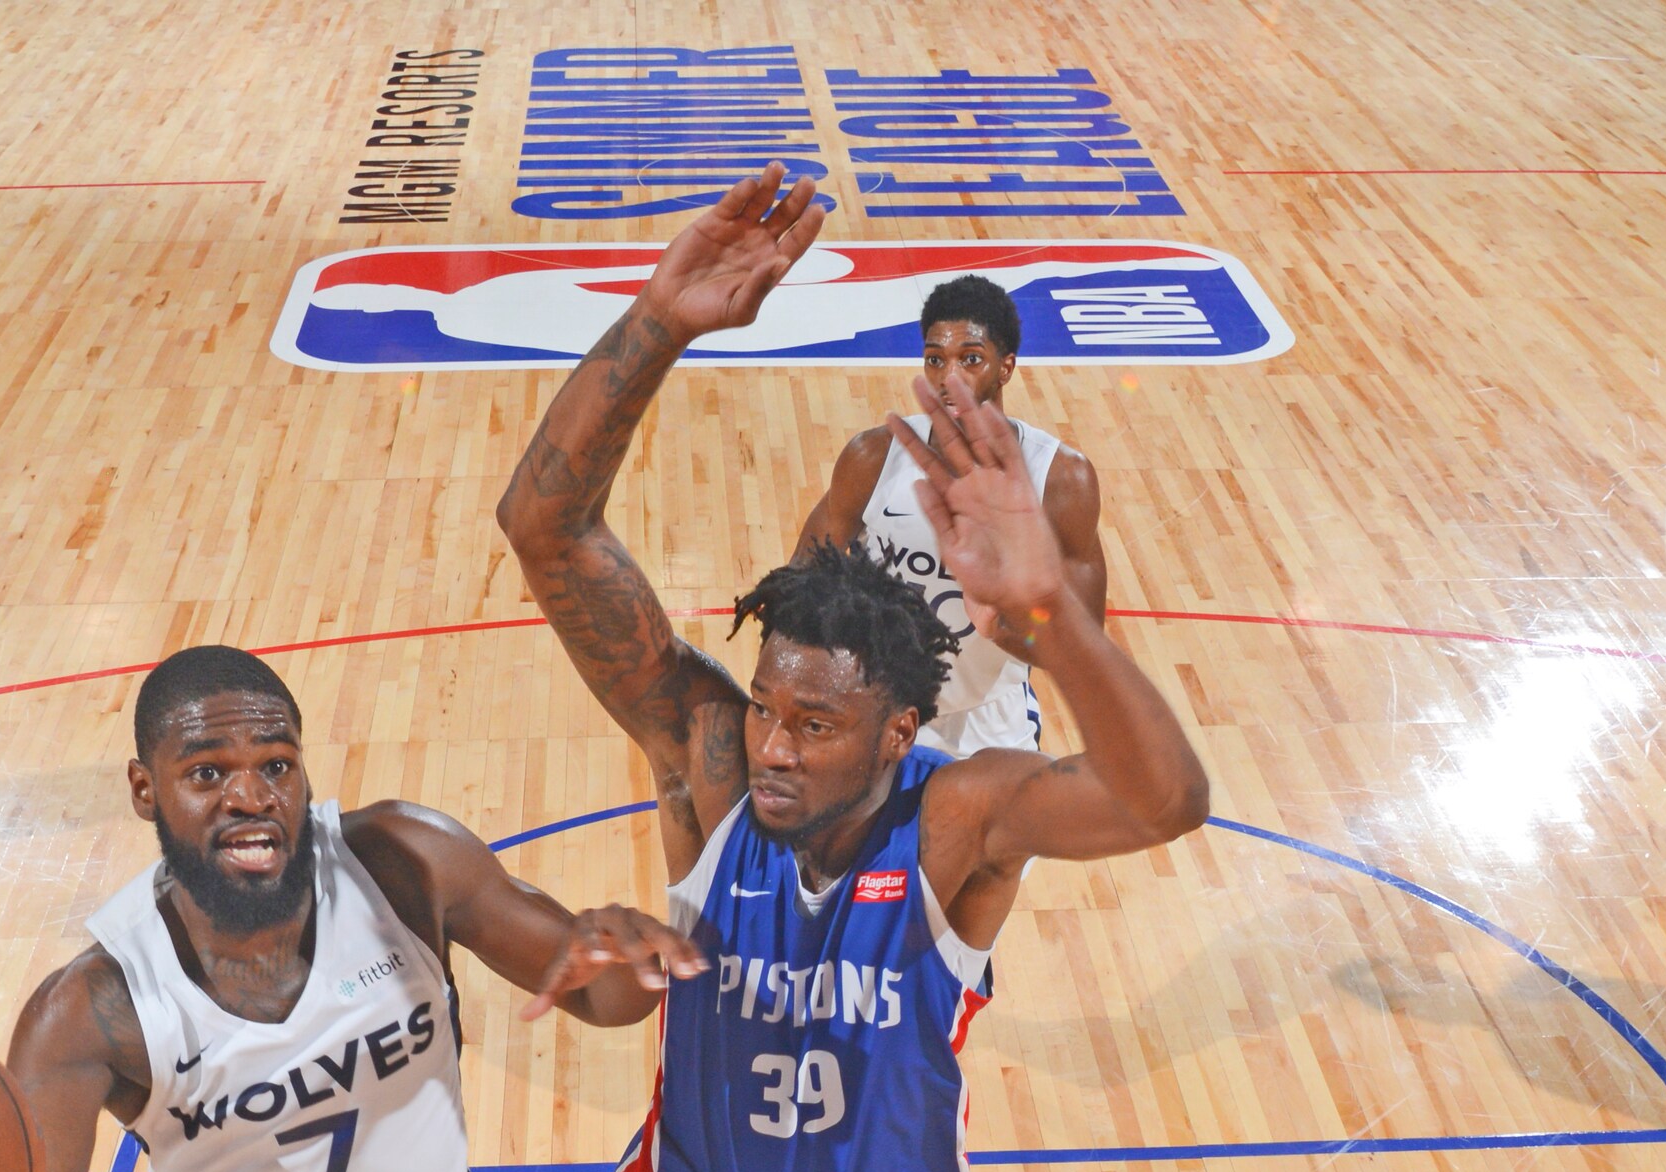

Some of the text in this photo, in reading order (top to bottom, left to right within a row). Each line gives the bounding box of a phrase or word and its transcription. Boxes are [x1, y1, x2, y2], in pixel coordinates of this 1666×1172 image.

[338, 49, 485, 224] MGM RESORTS
[511, 45, 838, 220] SUMMER
[824, 68, 1187, 218] LEAGUE
[1050, 284, 1222, 346] NBA
[857, 874, 906, 891] Flagstar
[885, 888, 904, 898] Bank
[358, 952, 405, 988] fitbit
[716, 953, 903, 1029] PISTONS
[167, 1001, 435, 1141] WOLVES
[749, 1049, 846, 1139] 39
